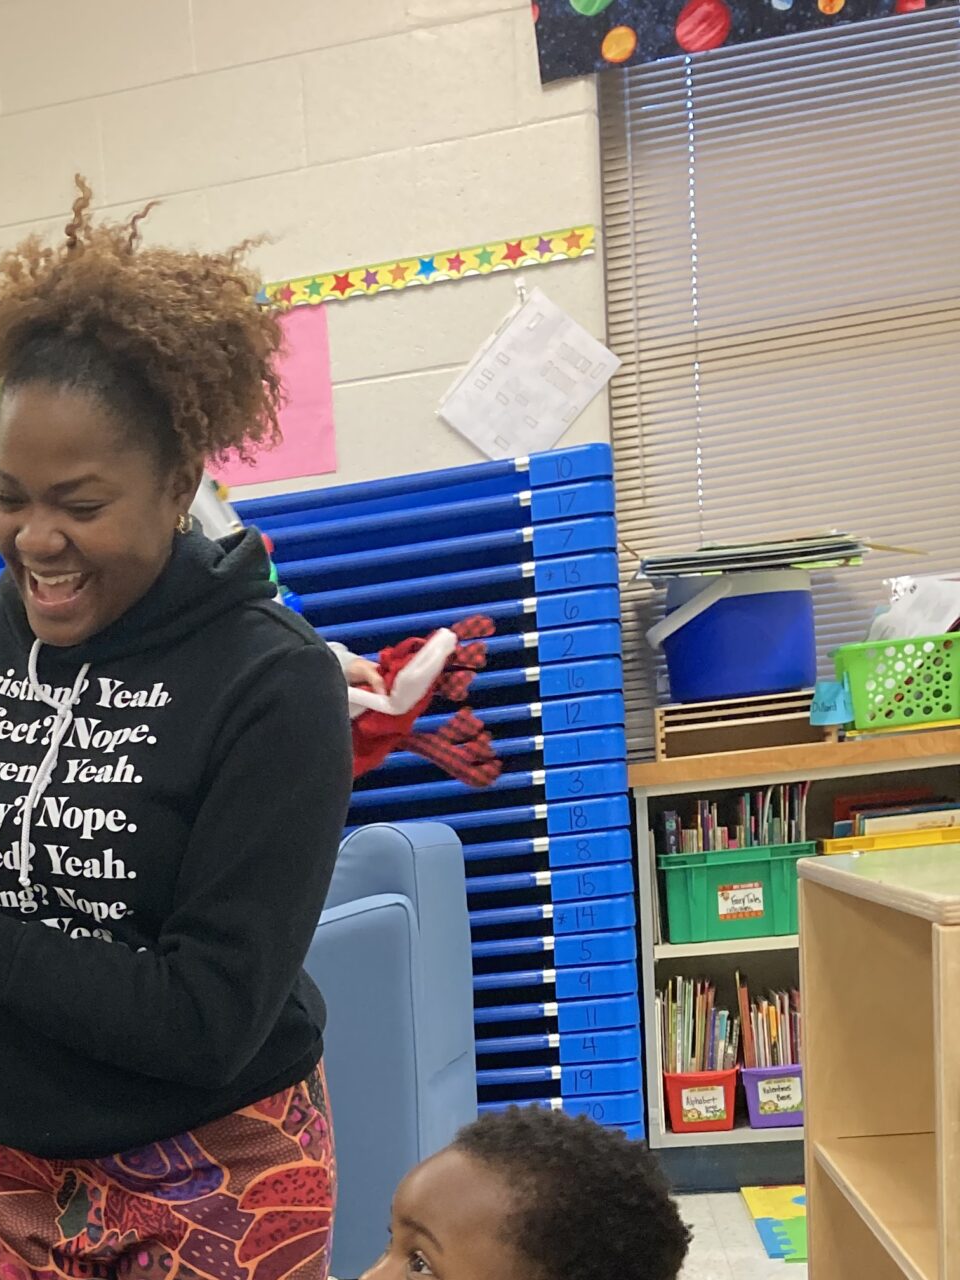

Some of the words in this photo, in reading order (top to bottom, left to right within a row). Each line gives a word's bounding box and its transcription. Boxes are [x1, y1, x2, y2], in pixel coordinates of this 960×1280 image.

[554, 456, 573, 479] 10
[558, 491, 577, 513] 17
[560, 528, 574, 547] 7
[562, 561, 581, 584] 13
[563, 599, 580, 620] 6
[562, 633, 576, 657] 2
[566, 702, 585, 724] 12
[63, 717, 157, 753] Nope.
[62, 755, 143, 784] Yeah.
[568, 770, 584, 793] 3
[35, 796, 137, 840] Nope.
[569, 806, 587, 830] 18
[576, 839, 591, 861] 8
[43, 844, 137, 879] Yeah.
[578, 872, 596, 895] 15
[53, 886, 134, 923] Nope.
[576, 906, 596, 928] 14
[580, 939, 593, 961] 5
[579, 971, 591, 991] 9
[586, 1007, 597, 1026] 11
[582, 1036, 597, 1056] 4
[574, 1070, 593, 1092] 19
